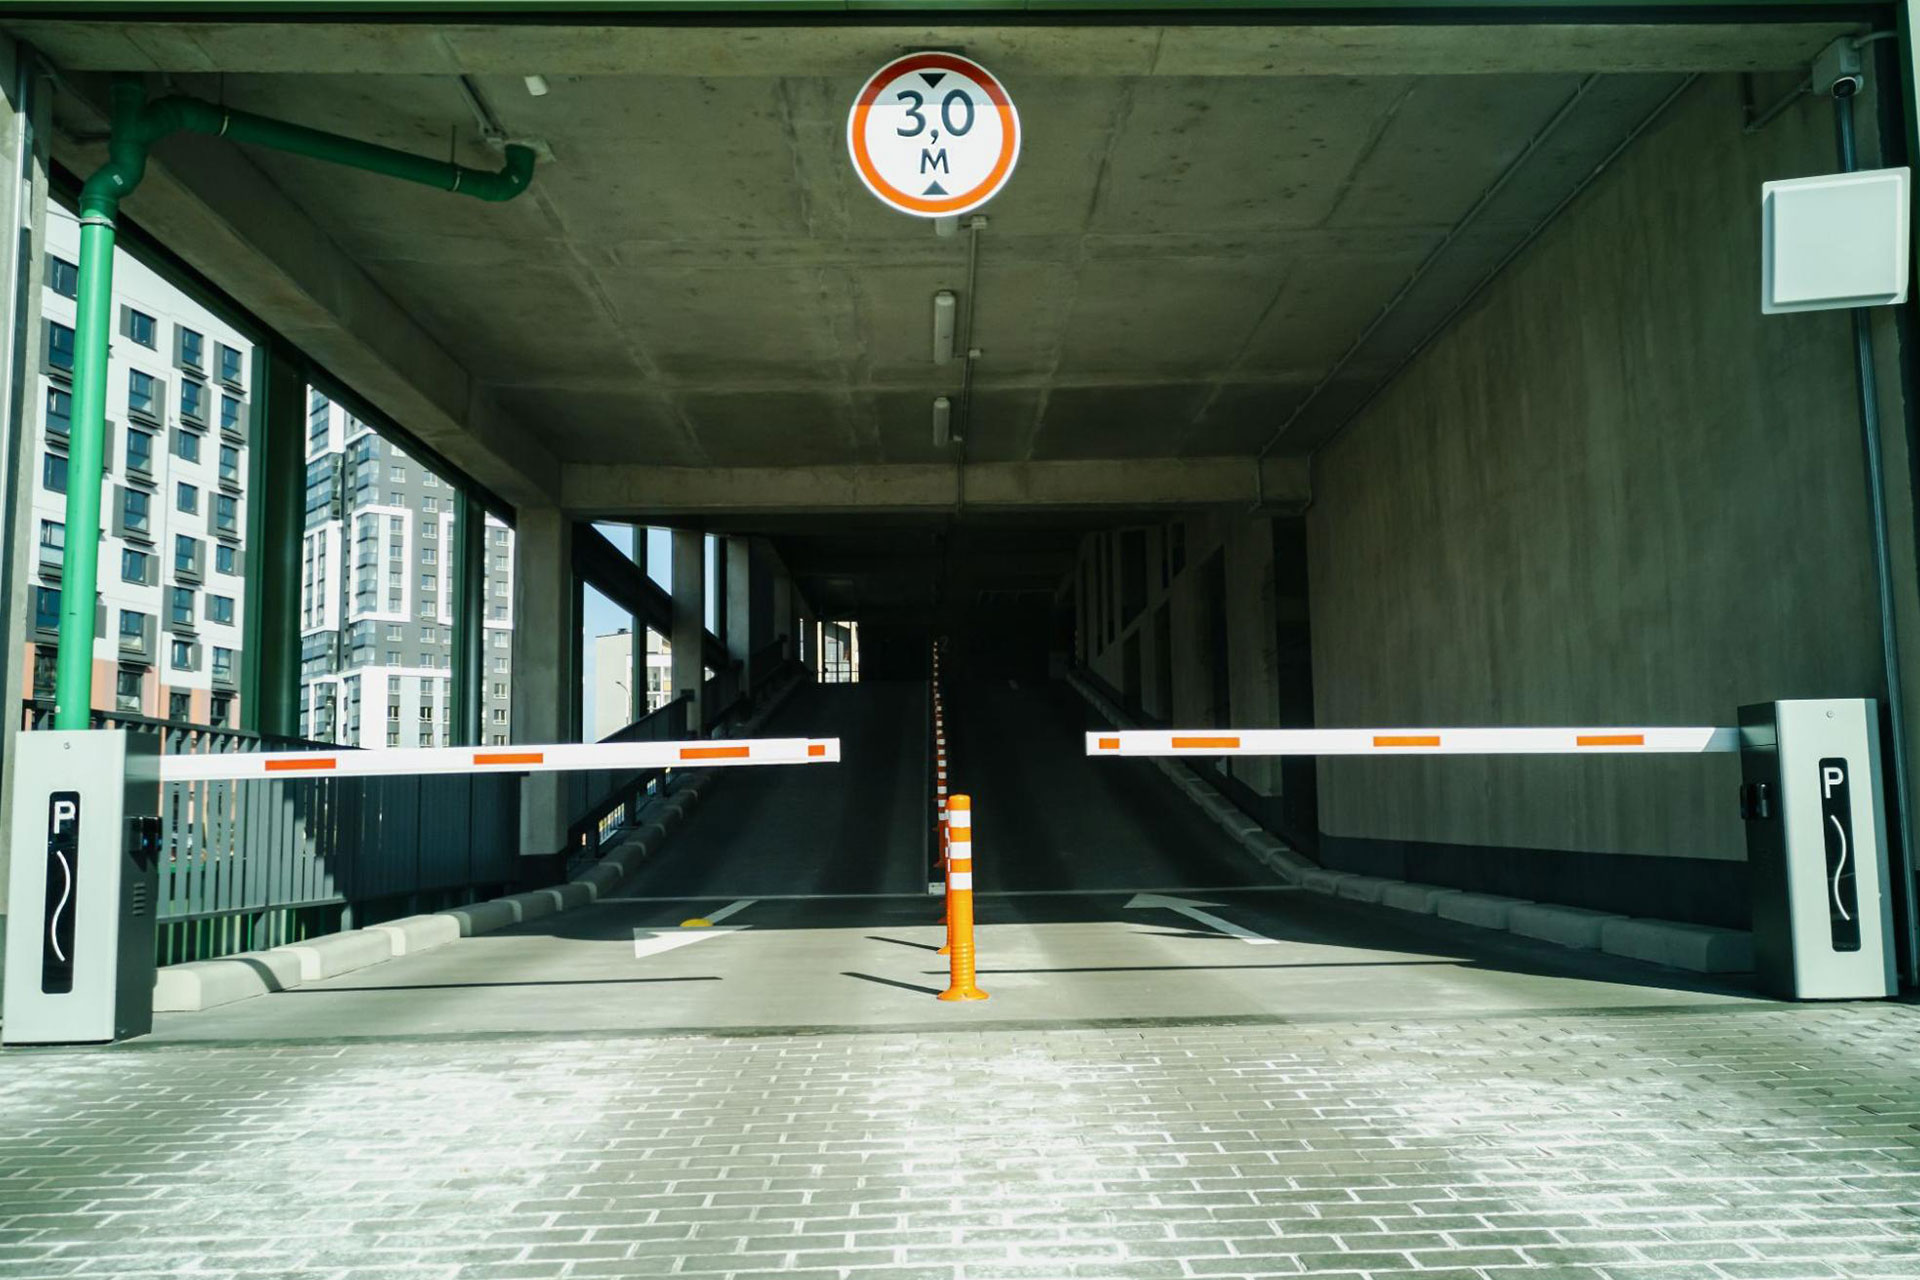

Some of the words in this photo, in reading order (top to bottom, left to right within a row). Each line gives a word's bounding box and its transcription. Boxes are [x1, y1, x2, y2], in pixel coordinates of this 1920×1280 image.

[897, 88, 975, 144] 3,0
[1823, 767, 1844, 799] P
[53, 801, 76, 834] P
